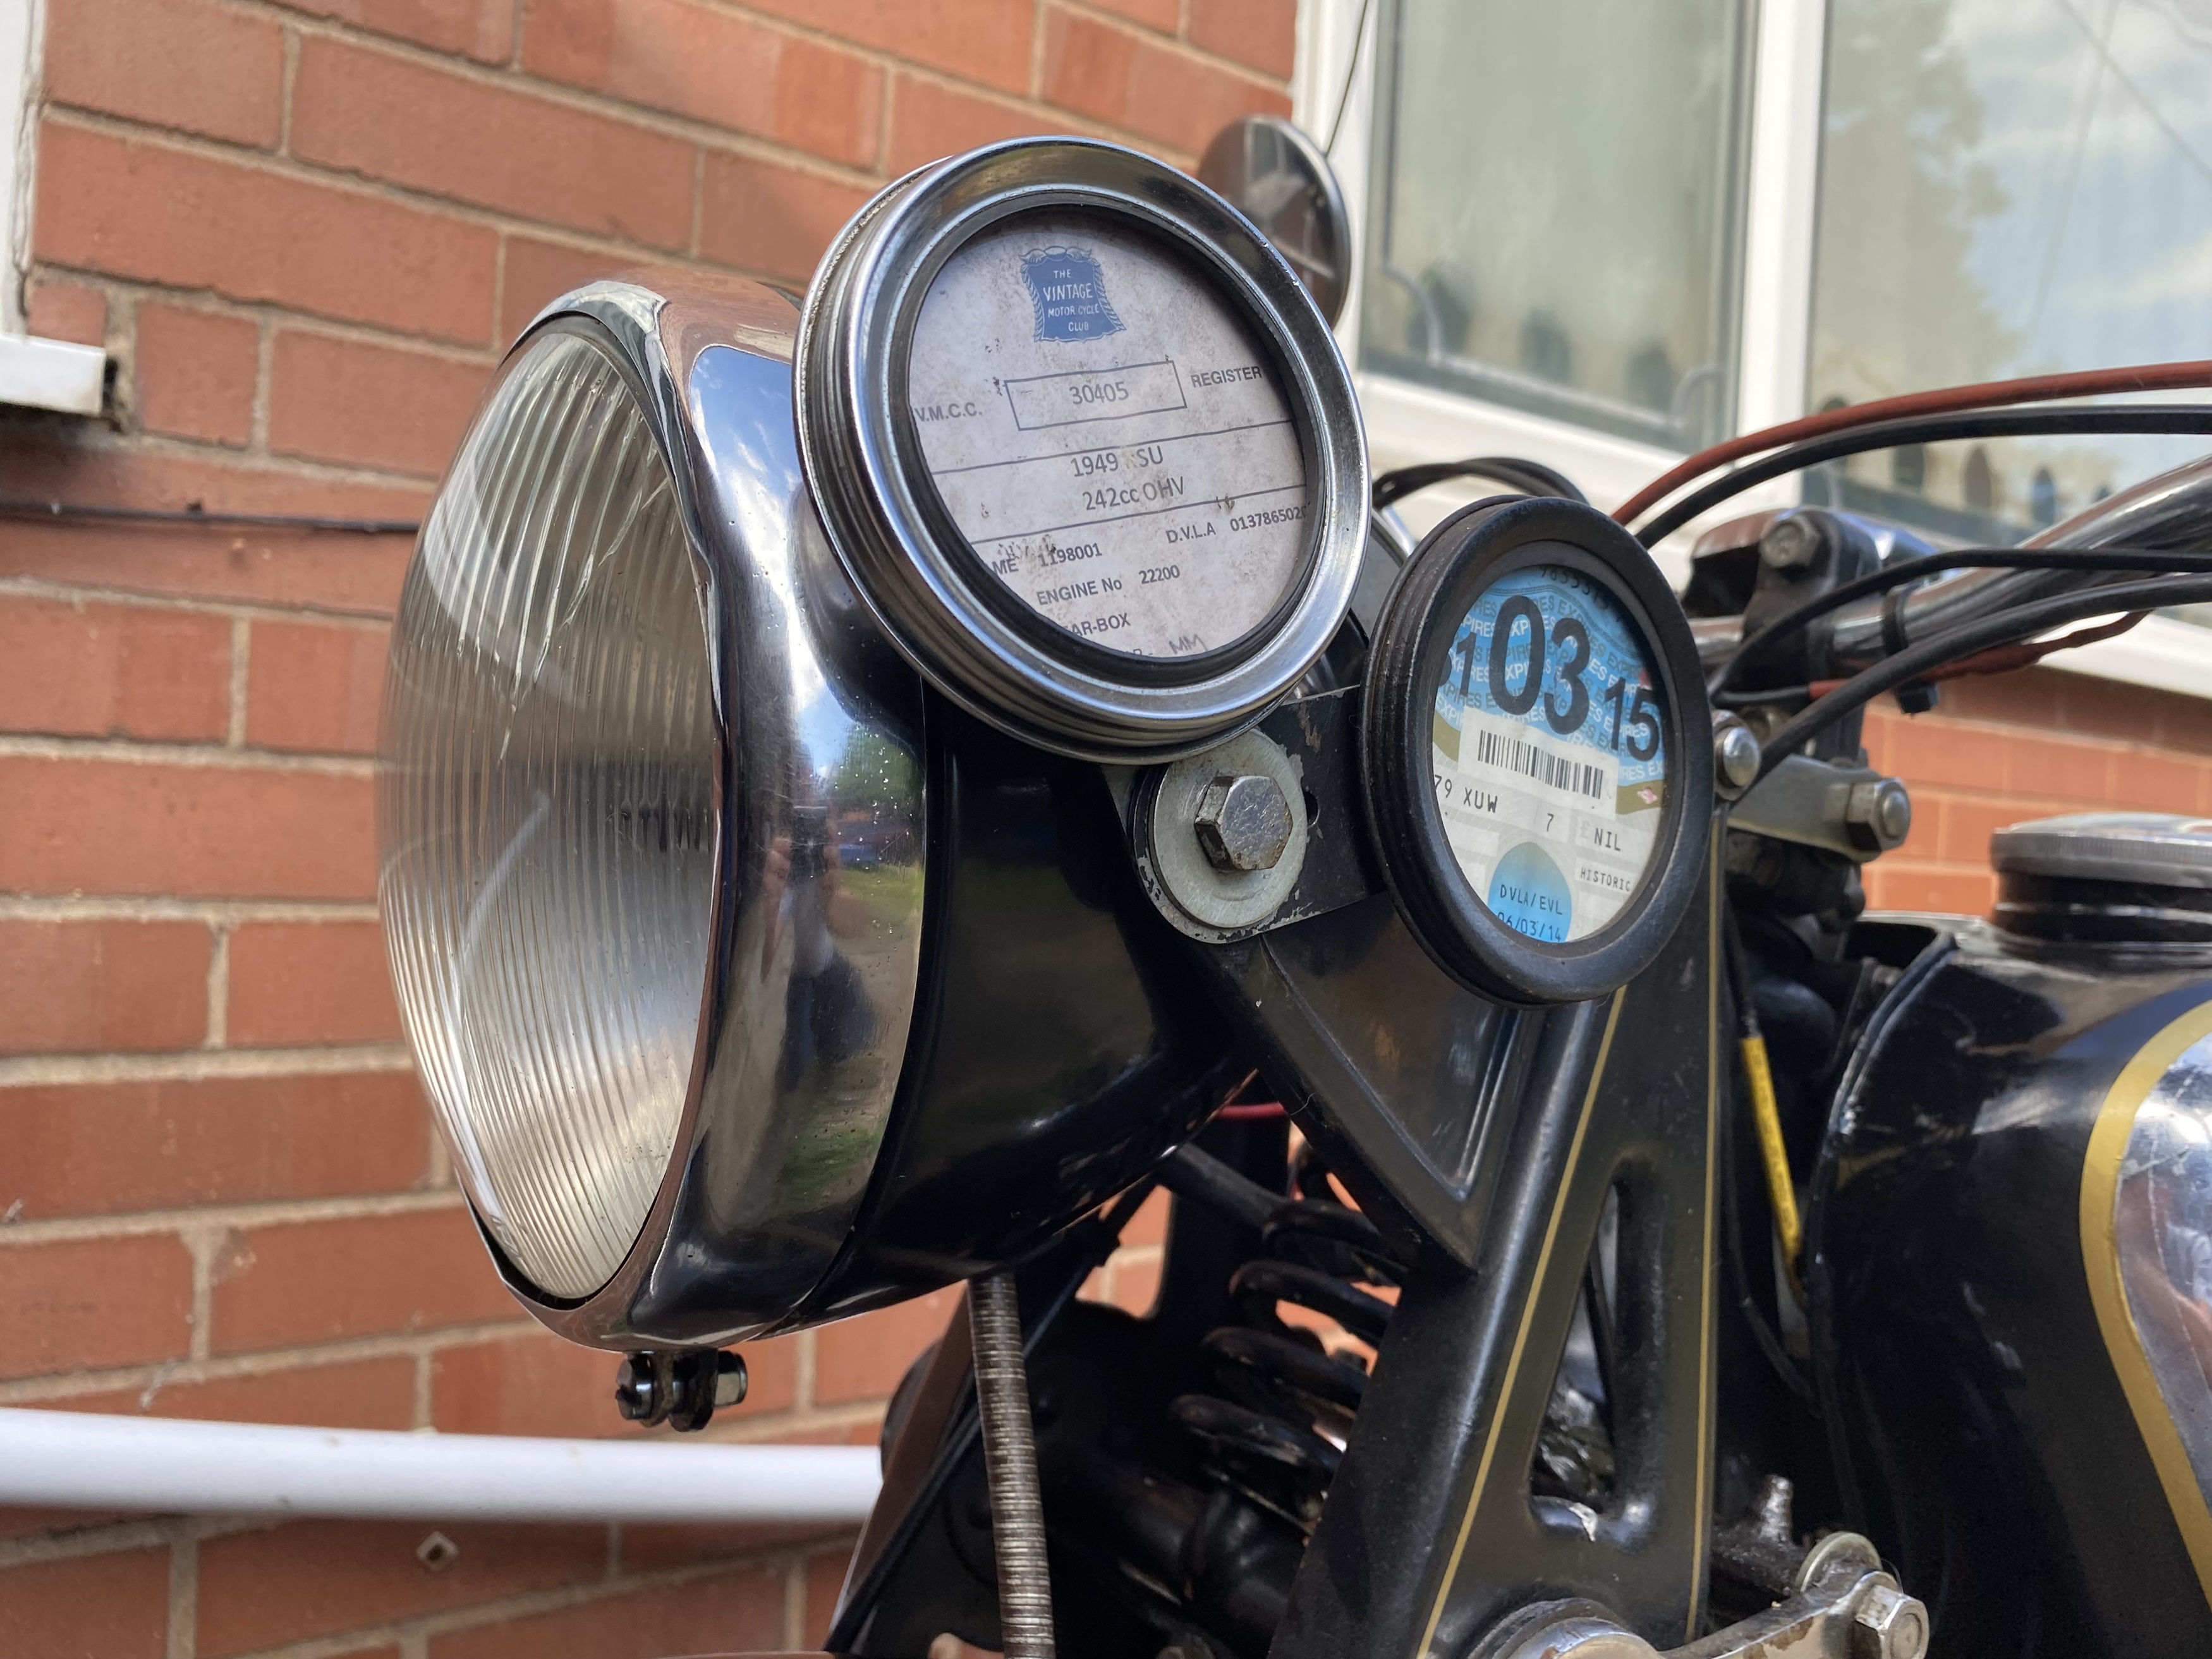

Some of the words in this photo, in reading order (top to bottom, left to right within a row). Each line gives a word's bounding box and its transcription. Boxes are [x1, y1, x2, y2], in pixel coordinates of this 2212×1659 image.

[1053, 269, 1071, 279] THE
[1043, 283, 1093, 301] VINTAGE
[1048, 306, 1076, 317] MOTOR
[1078, 303, 1100, 315] CYCLE
[1068, 321, 1090, 332] CLUB
[1190, 366, 1263, 388] REGISTER
[1069, 381, 1130, 405] 30405
[915, 402, 982, 422] V.M.C.C.
[1070, 446, 1119, 477] 1949
[1137, 439, 1164, 468] SU
[1082, 487, 1140, 511] 242cc
[1143, 476, 1184, 502] OHV
[1165, 522, 1216, 544] D.V.L.A
[1038, 542, 1102, 567] 1198001
[1036, 581, 1098, 605] ENGINE
[1102, 577, 1122, 593] No
[1138, 564, 1181, 585] 22200
[1062, 612, 1131, 637] AR-BOX
[1489, 595, 1591, 735] 03
[1604, 676, 1660, 762] 15
[1463, 787, 1498, 813] XUW
[1547, 812, 1555, 832] 7
[1594, 827, 1621, 852] NIL
[1580, 867, 1631, 892] HISTORIC
[1500, 884, 1563, 916] DVLA/EVL
